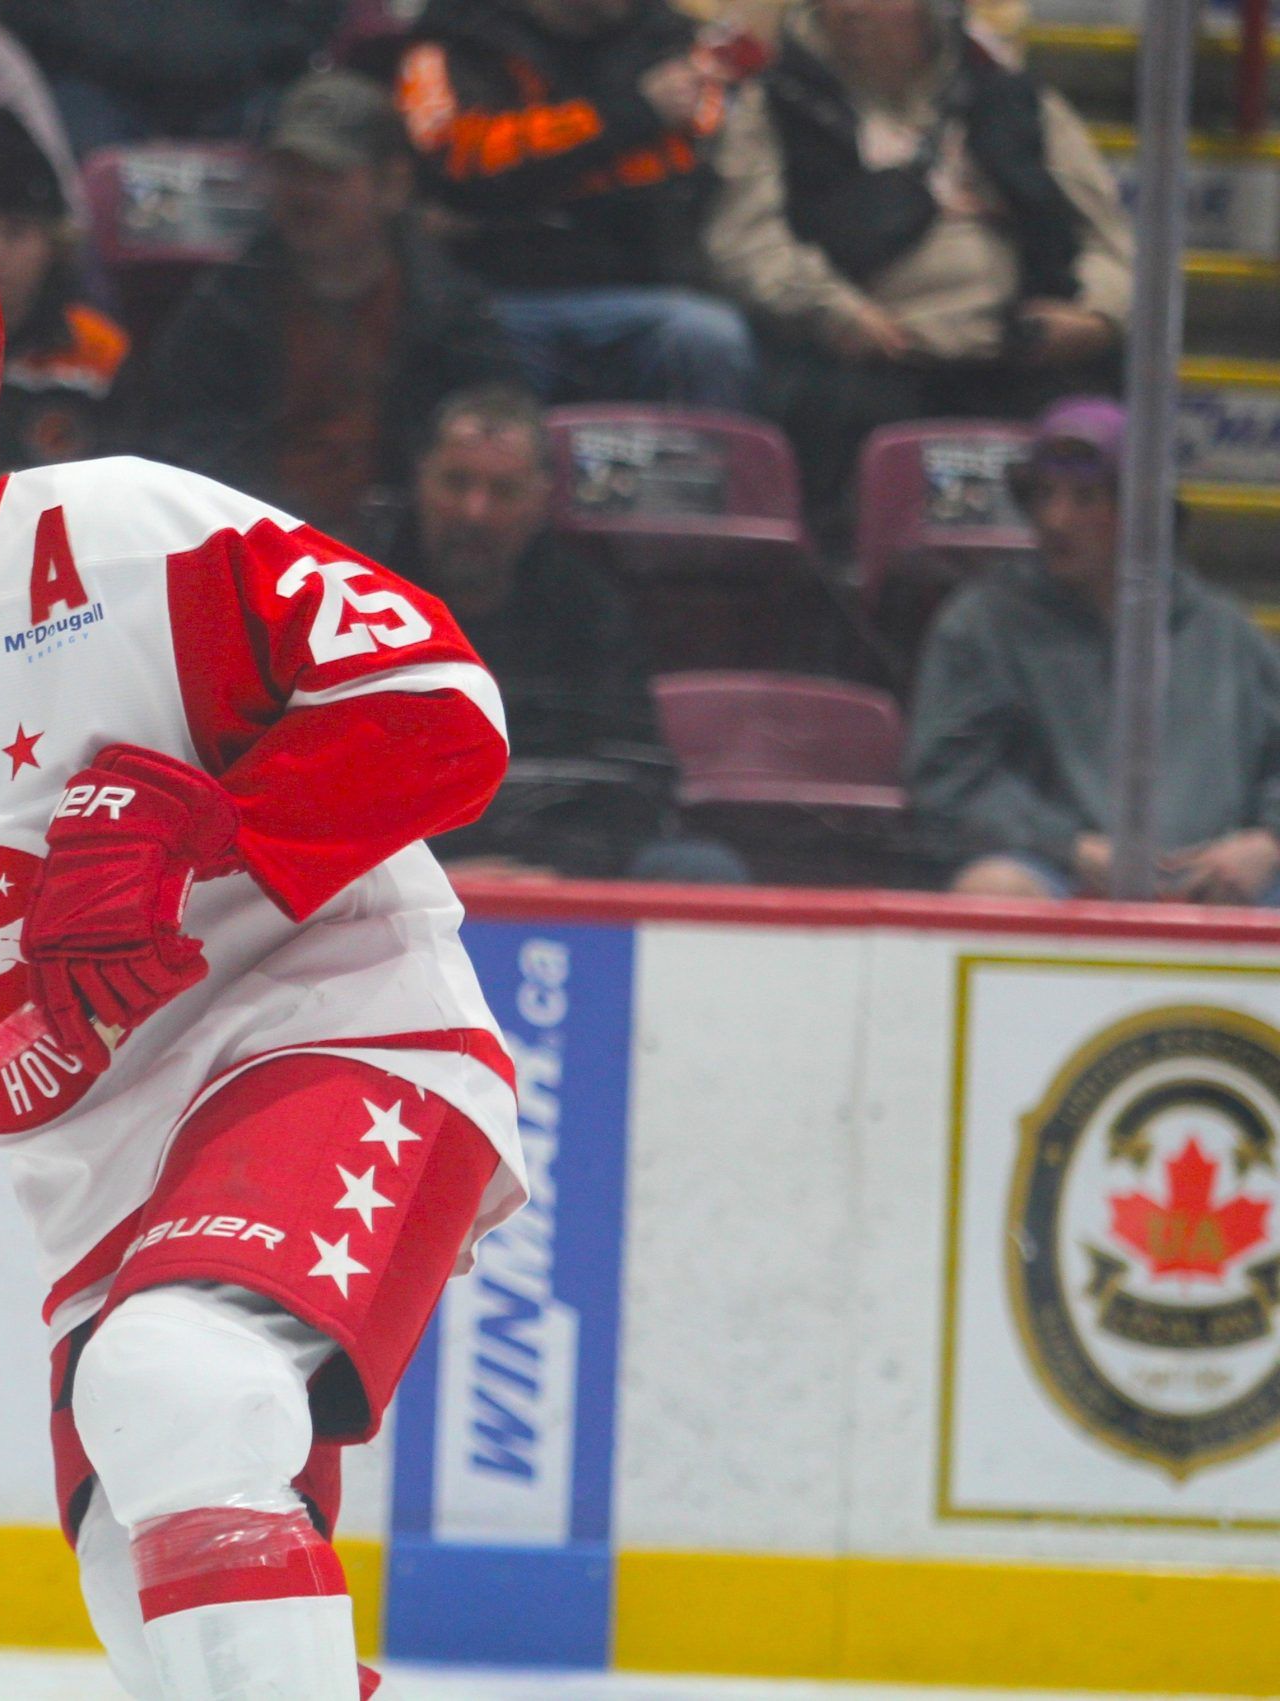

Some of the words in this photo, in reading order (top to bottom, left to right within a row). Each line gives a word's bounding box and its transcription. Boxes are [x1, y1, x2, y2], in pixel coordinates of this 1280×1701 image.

[30, 505, 89, 626] A
[276, 555, 433, 666] 25
[4, 603, 104, 653] McDougall
